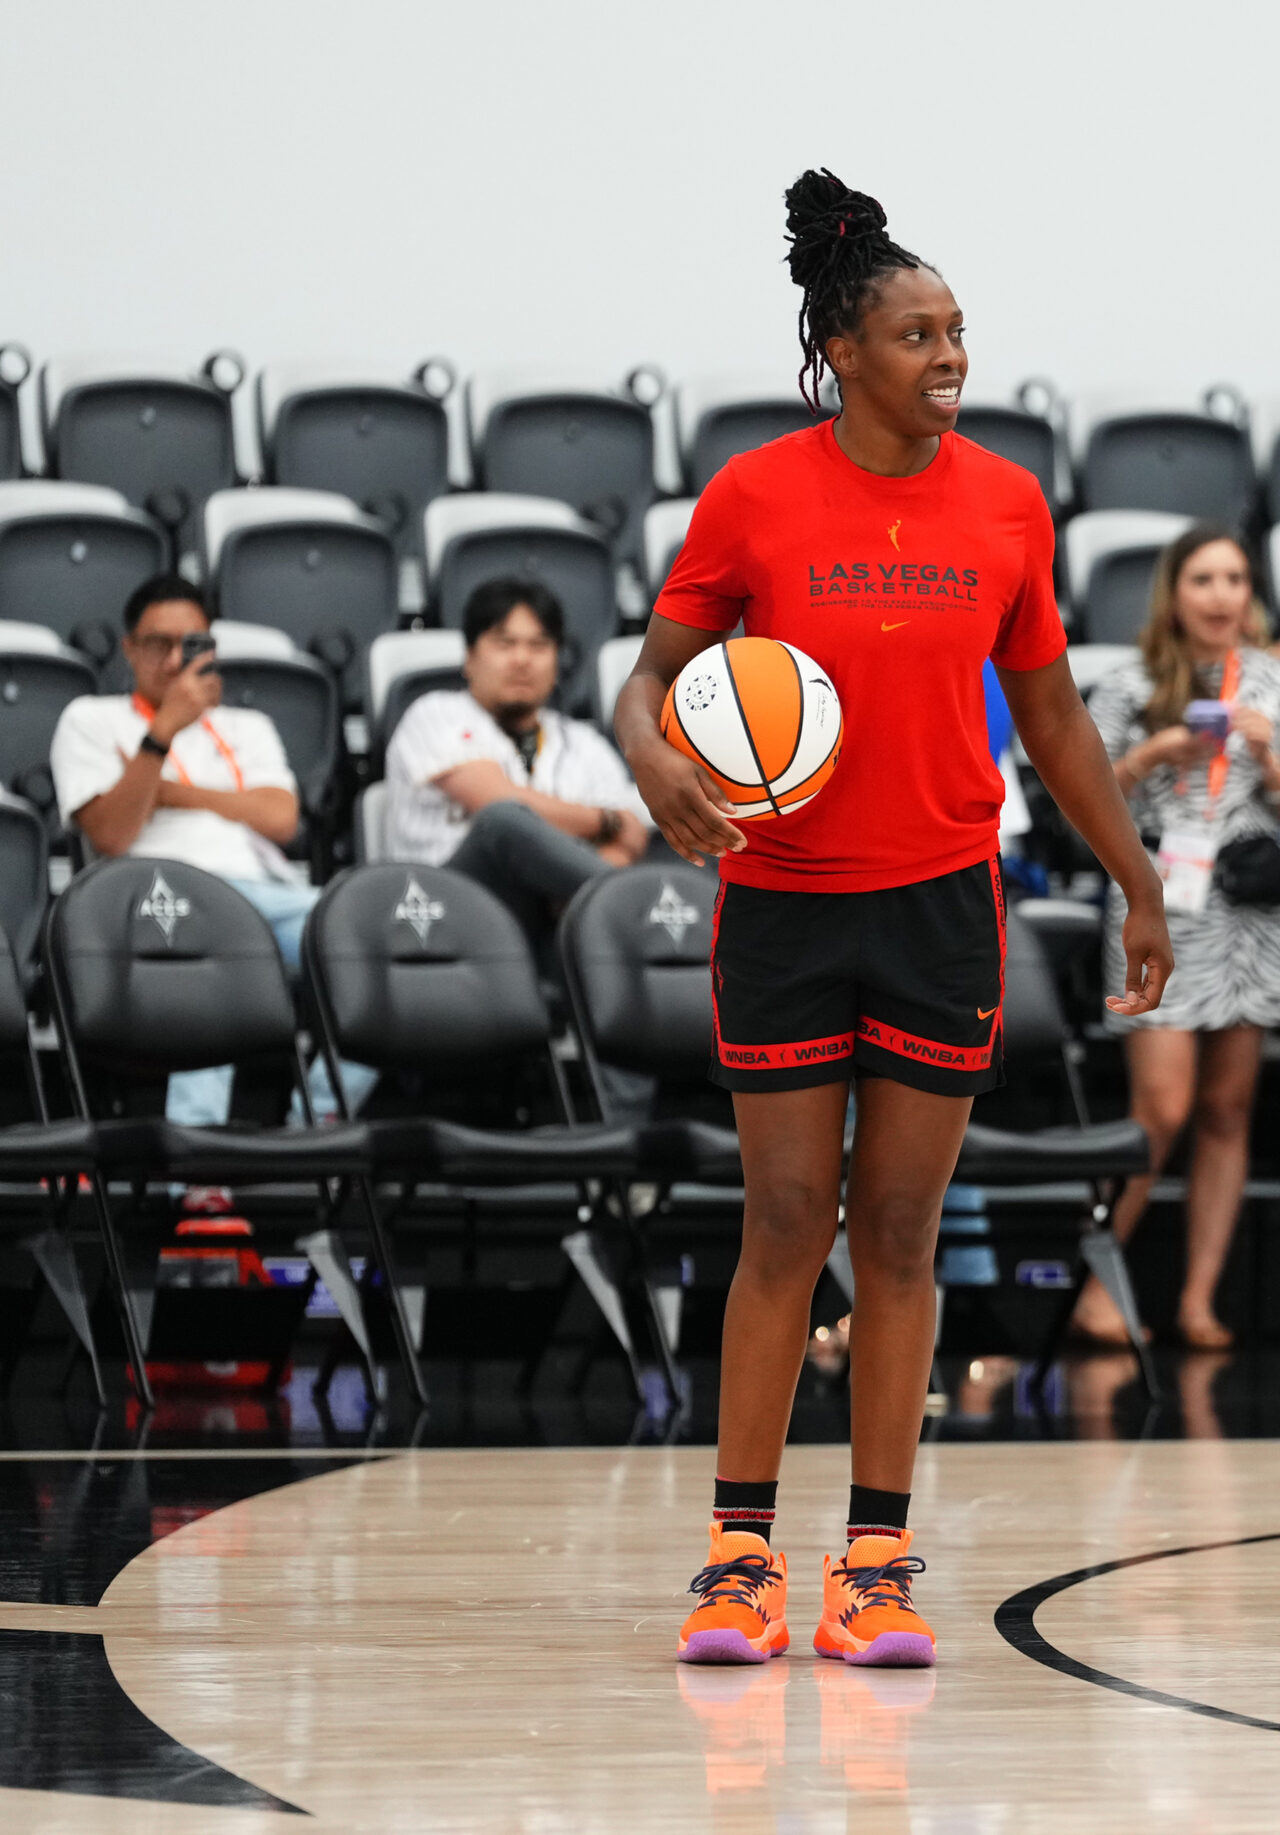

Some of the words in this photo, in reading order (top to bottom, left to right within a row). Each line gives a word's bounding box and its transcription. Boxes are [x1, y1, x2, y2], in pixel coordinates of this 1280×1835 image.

[809, 563, 870, 582] LAS
[877, 563, 978, 587] VEGAS
[809, 582, 978, 602] BASKETBALL
[725, 1050, 770, 1064] WNBA
[794, 1041, 850, 1060] WNBA
[903, 1039, 965, 1065] WNBA
